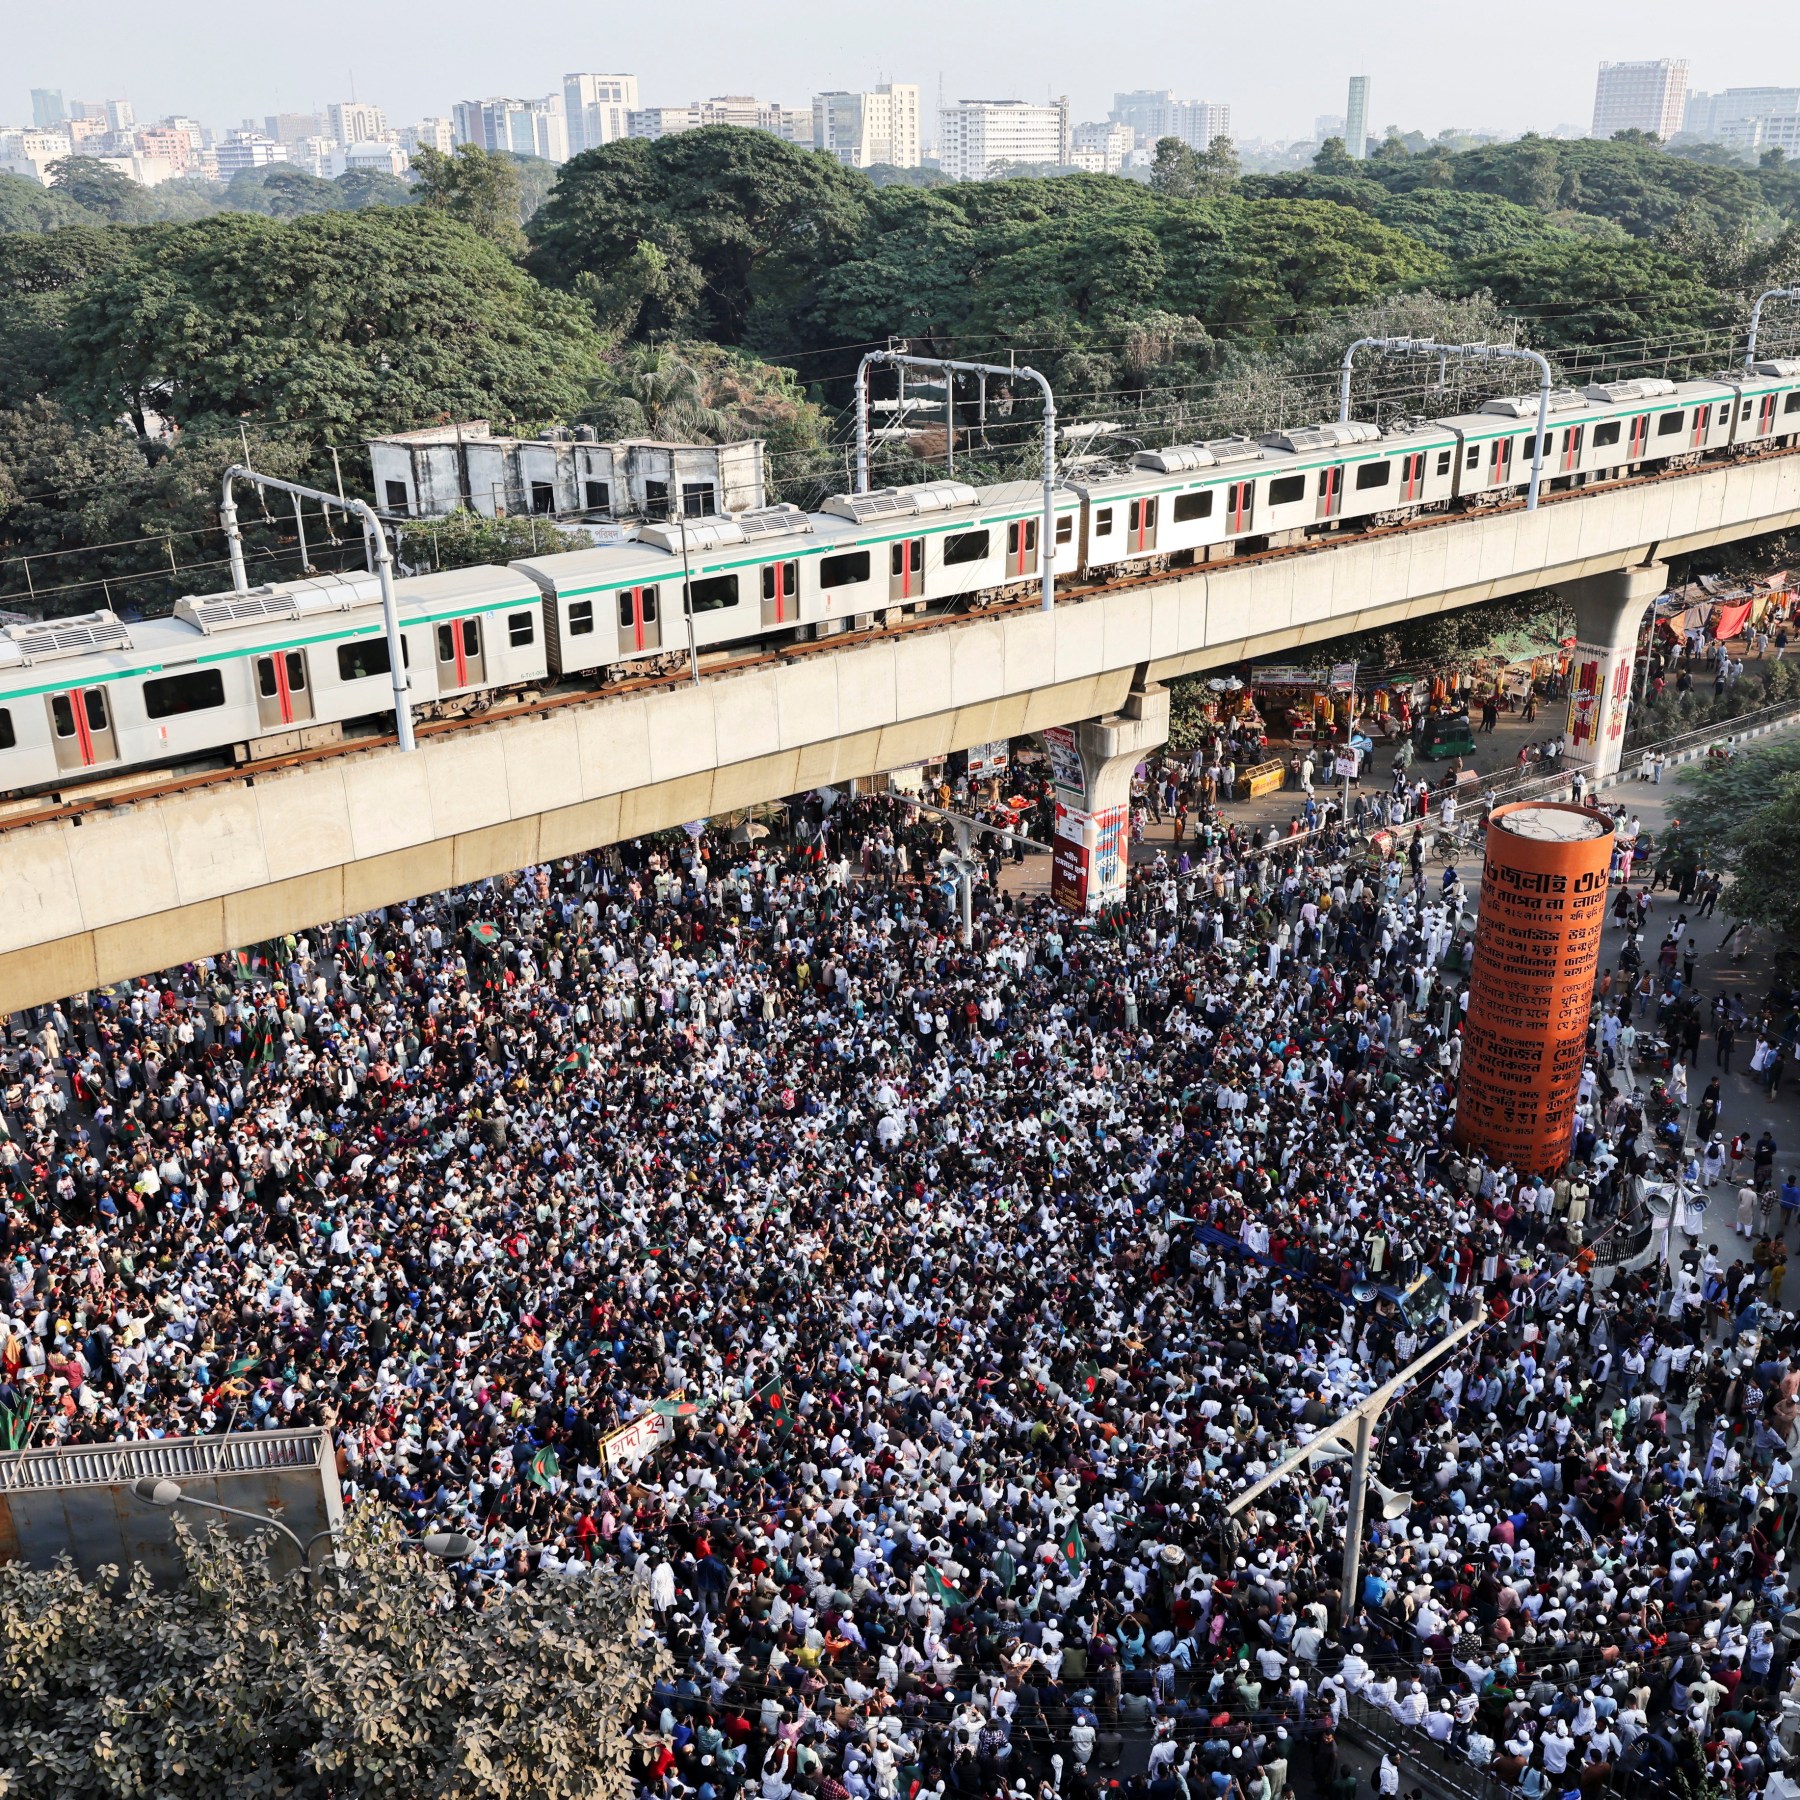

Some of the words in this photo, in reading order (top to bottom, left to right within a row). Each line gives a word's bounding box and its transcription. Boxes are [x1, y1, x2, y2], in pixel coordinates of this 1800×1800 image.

[1500, 864, 1568, 895] জুলাই
[1568, 928, 1586, 940] উই
[1508, 990, 1553, 1006] ইতিহাস
[1526, 1009, 1550, 1019] মনে
[1559, 1008, 1573, 1019] সে
[1526, 1022, 1550, 1031] লাশ
[1488, 1040, 1543, 1062] মহাজন
[610, 1426, 641, 1456] হাদী
